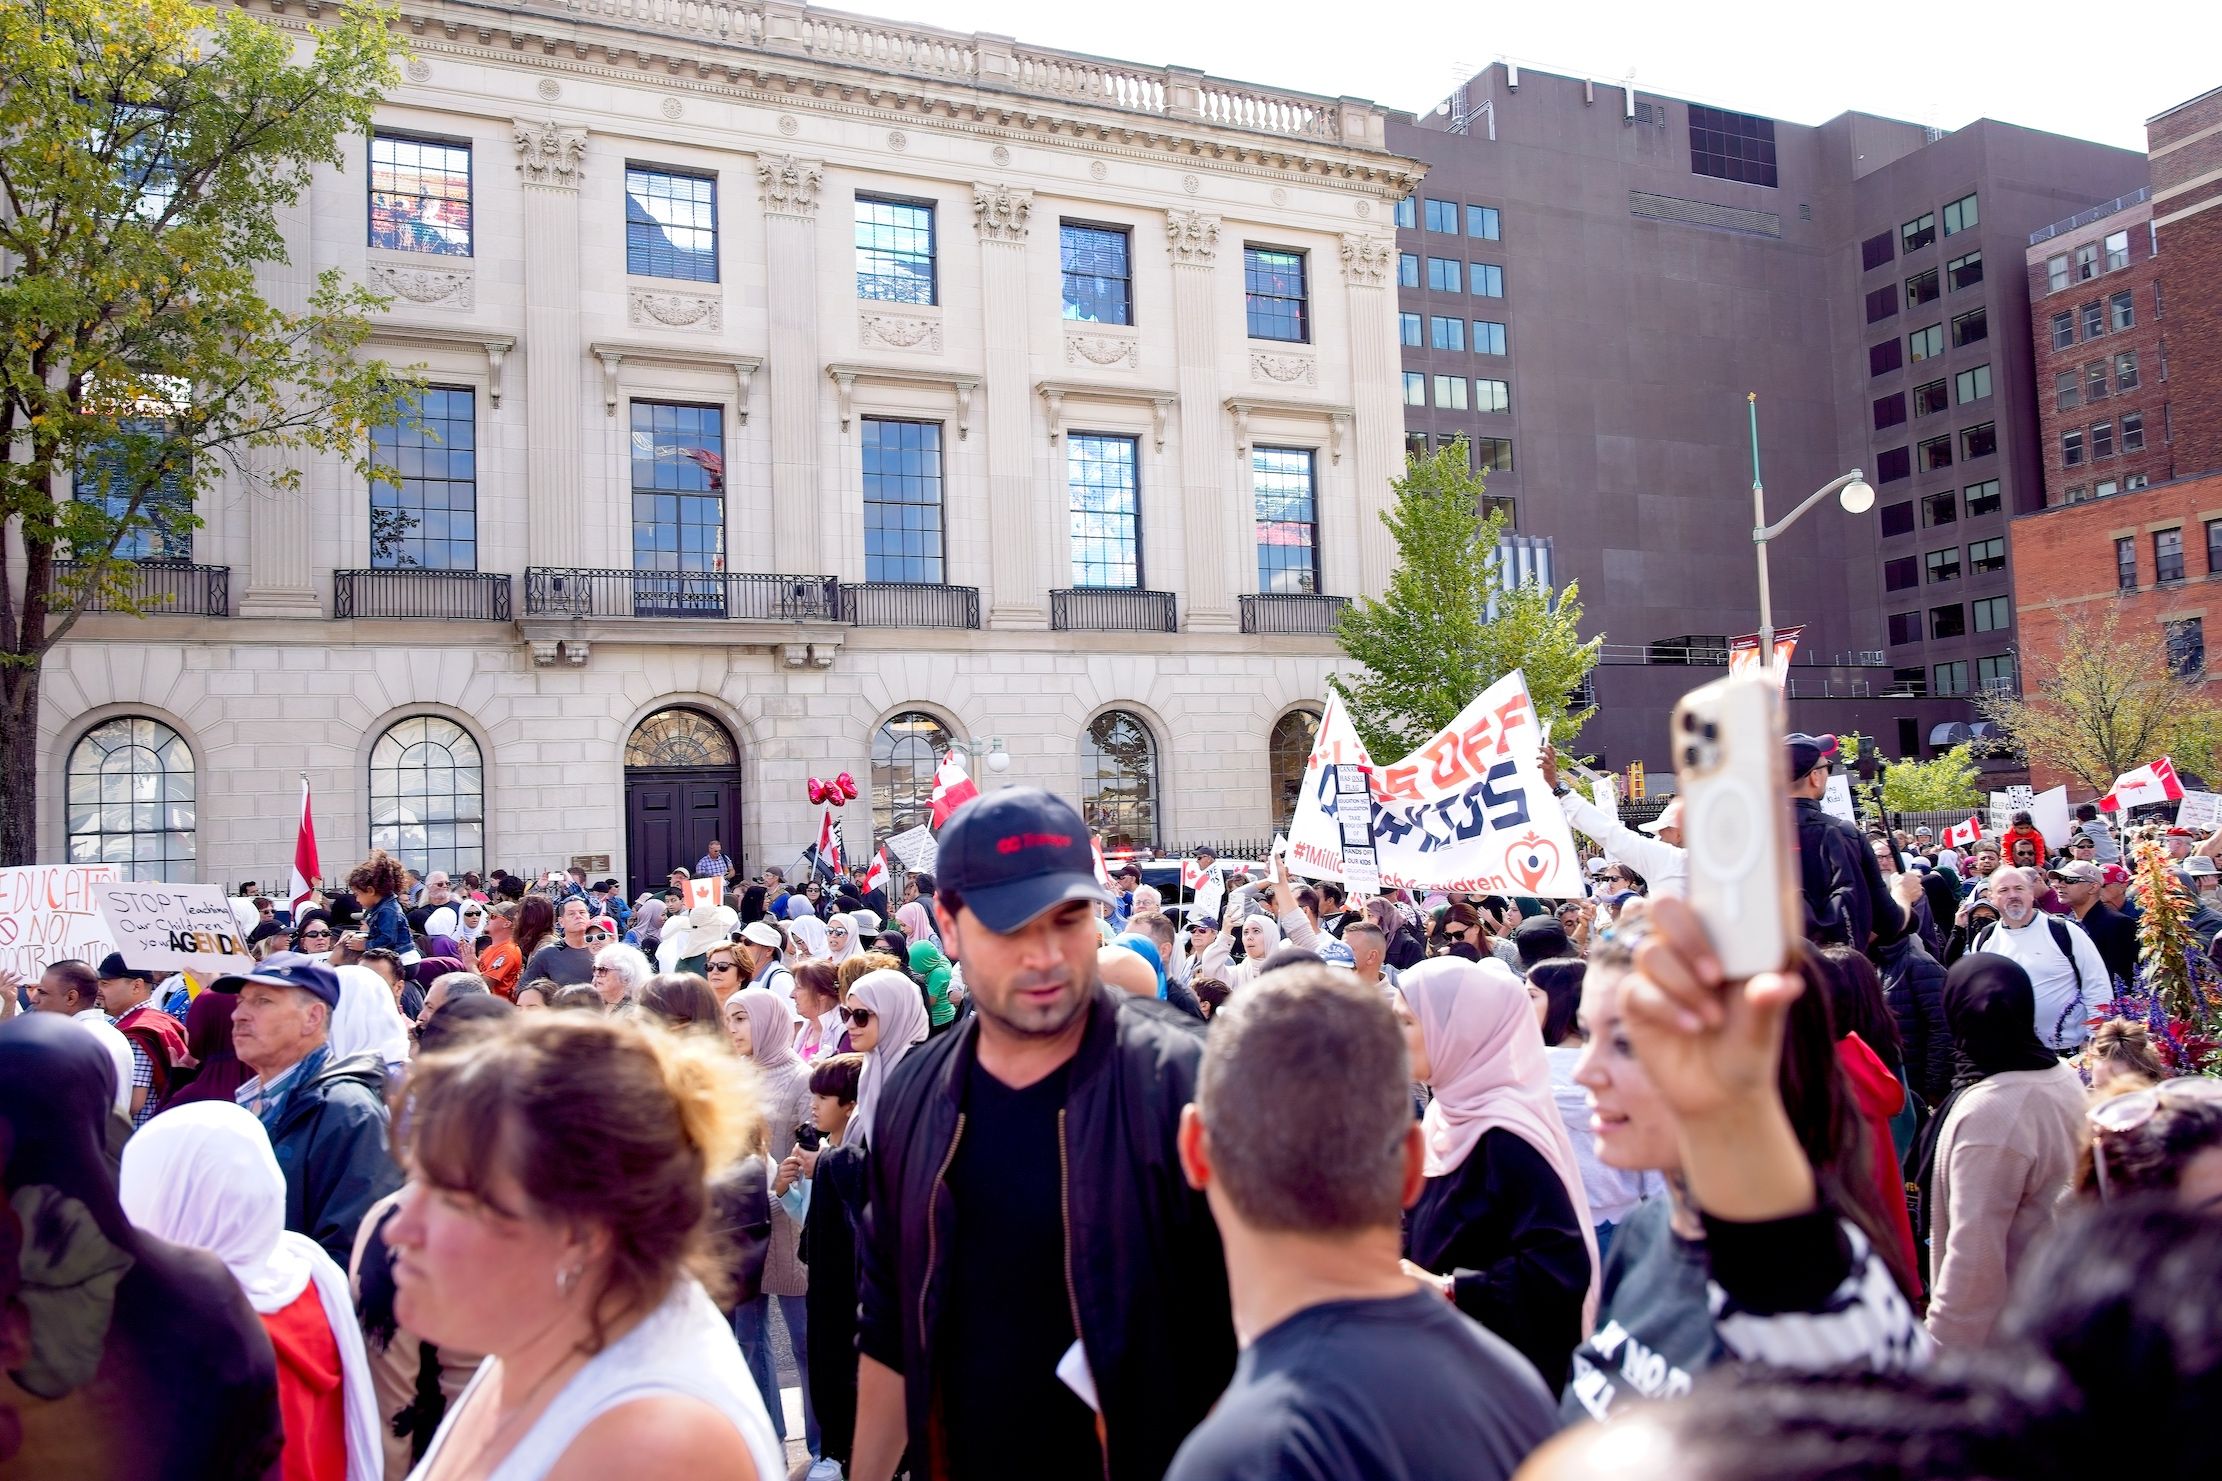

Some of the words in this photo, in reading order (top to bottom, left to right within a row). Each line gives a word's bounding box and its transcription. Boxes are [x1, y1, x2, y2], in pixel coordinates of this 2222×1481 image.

[1420, 692, 1528, 791] OFF
[1359, 858, 1372, 866] KIDS
[107, 891, 171, 913] STOP
[173, 894, 233, 925] Teaching
[28, 910, 95, 947] NOT
[120, 918, 151, 933] Our
[155, 917, 224, 932] Children
[139, 939, 171, 951] your
[169, 930, 250, 956] AGENDA
